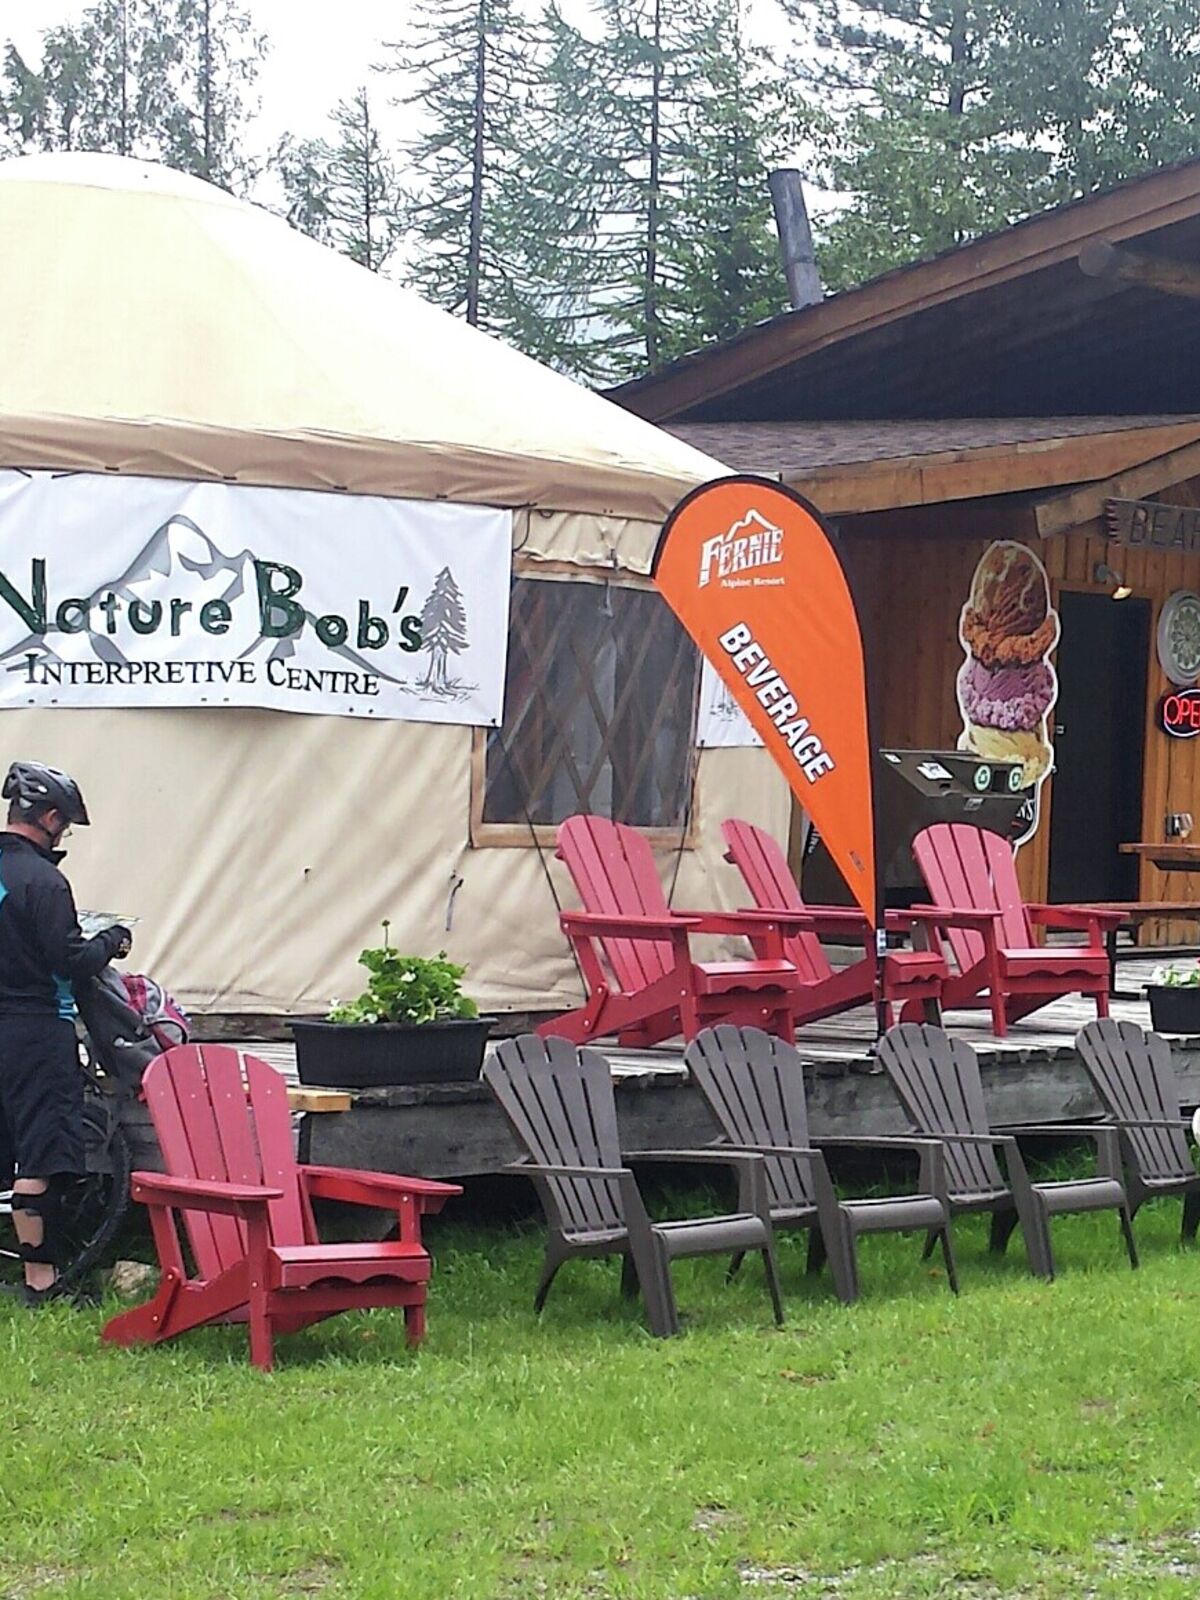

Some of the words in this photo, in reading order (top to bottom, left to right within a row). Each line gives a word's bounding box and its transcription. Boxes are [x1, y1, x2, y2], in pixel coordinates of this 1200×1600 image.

[0, 558, 233, 636] Nature
[254, 559, 424, 653] Bob's
[718, 622, 836, 785] BEVERAGE
